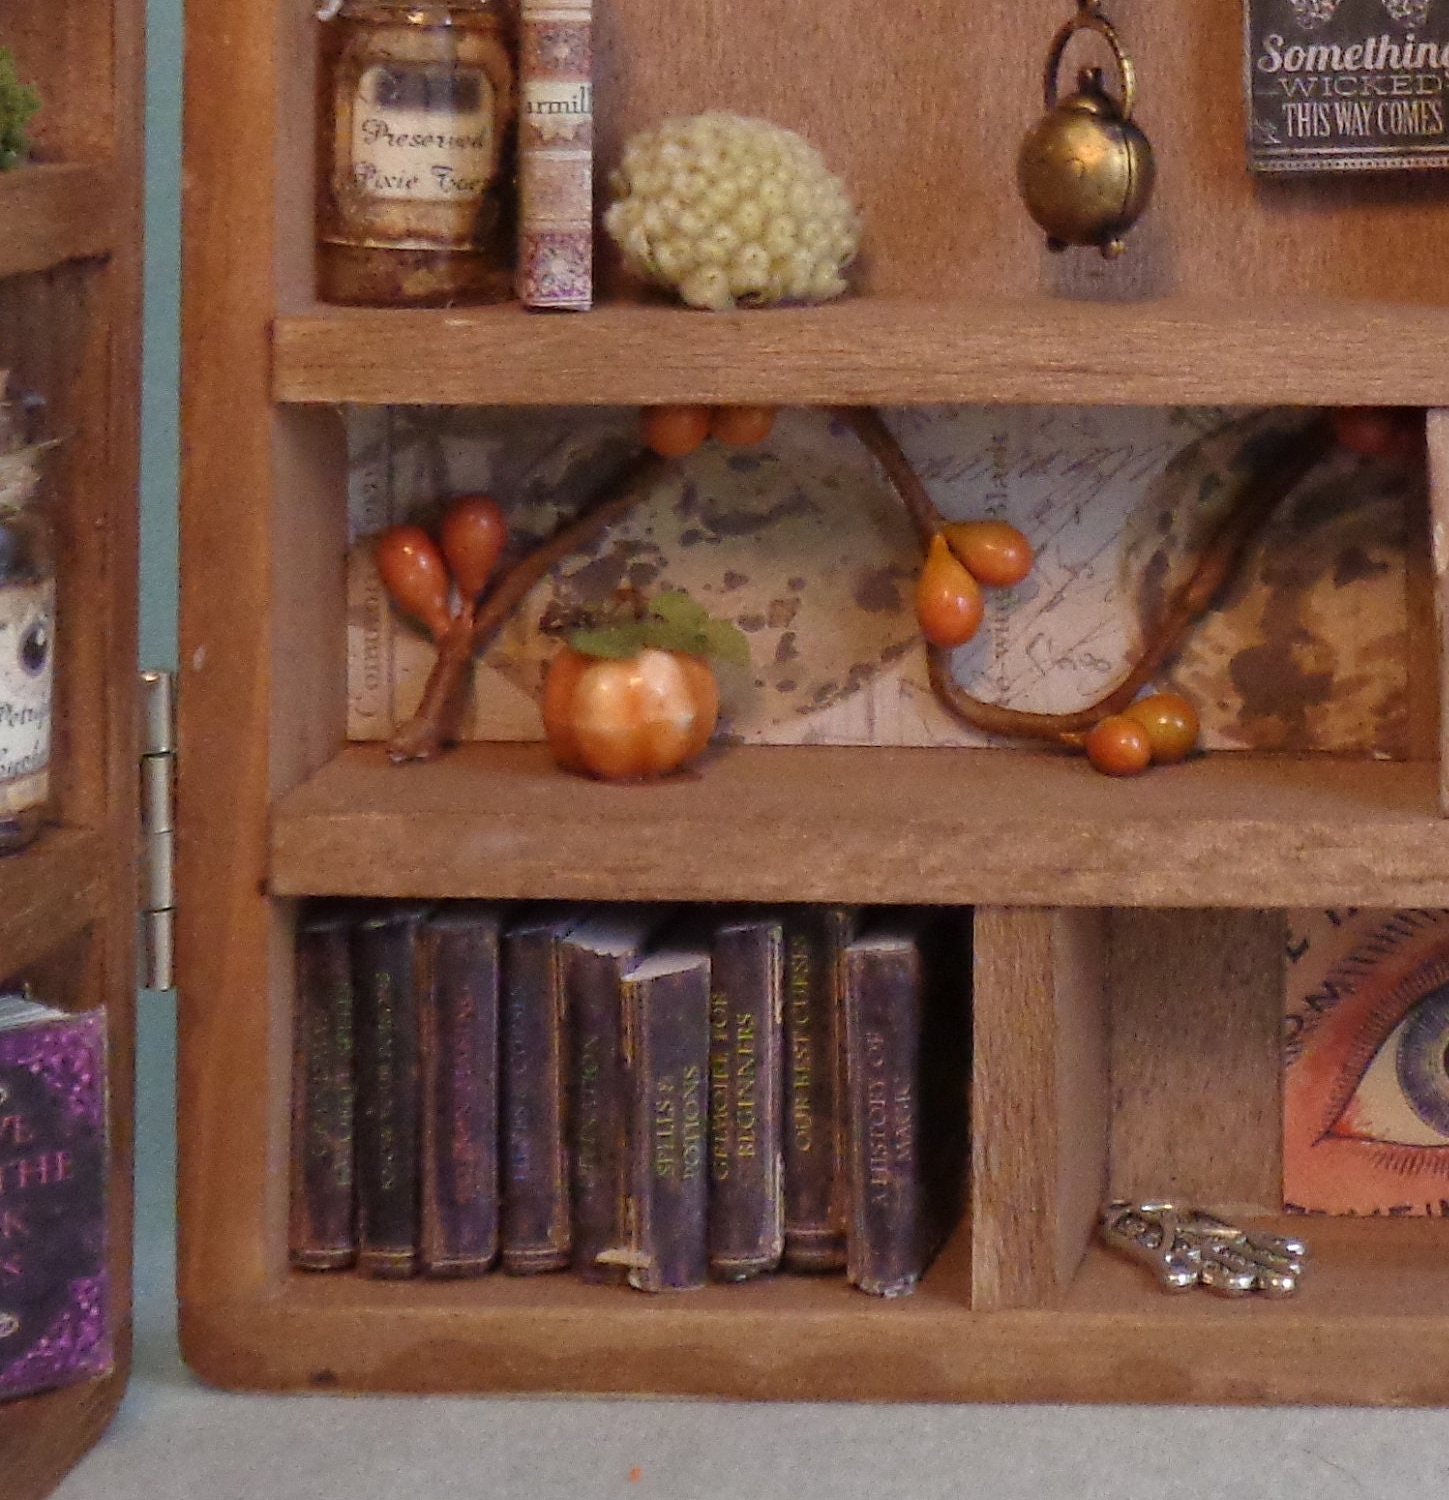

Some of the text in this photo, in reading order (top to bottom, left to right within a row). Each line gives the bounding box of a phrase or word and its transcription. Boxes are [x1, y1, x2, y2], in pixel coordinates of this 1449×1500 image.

[1279, 74, 1443, 98] WICKED
[1282, 100, 1444, 139] THIS WAY COMES
[736, 1011, 756, 1158] BEGINNERS
[792, 1031, 811, 1088] BEST
[682, 1064, 699, 1181] POTIONS
[793, 1096, 812, 1153] OUR
